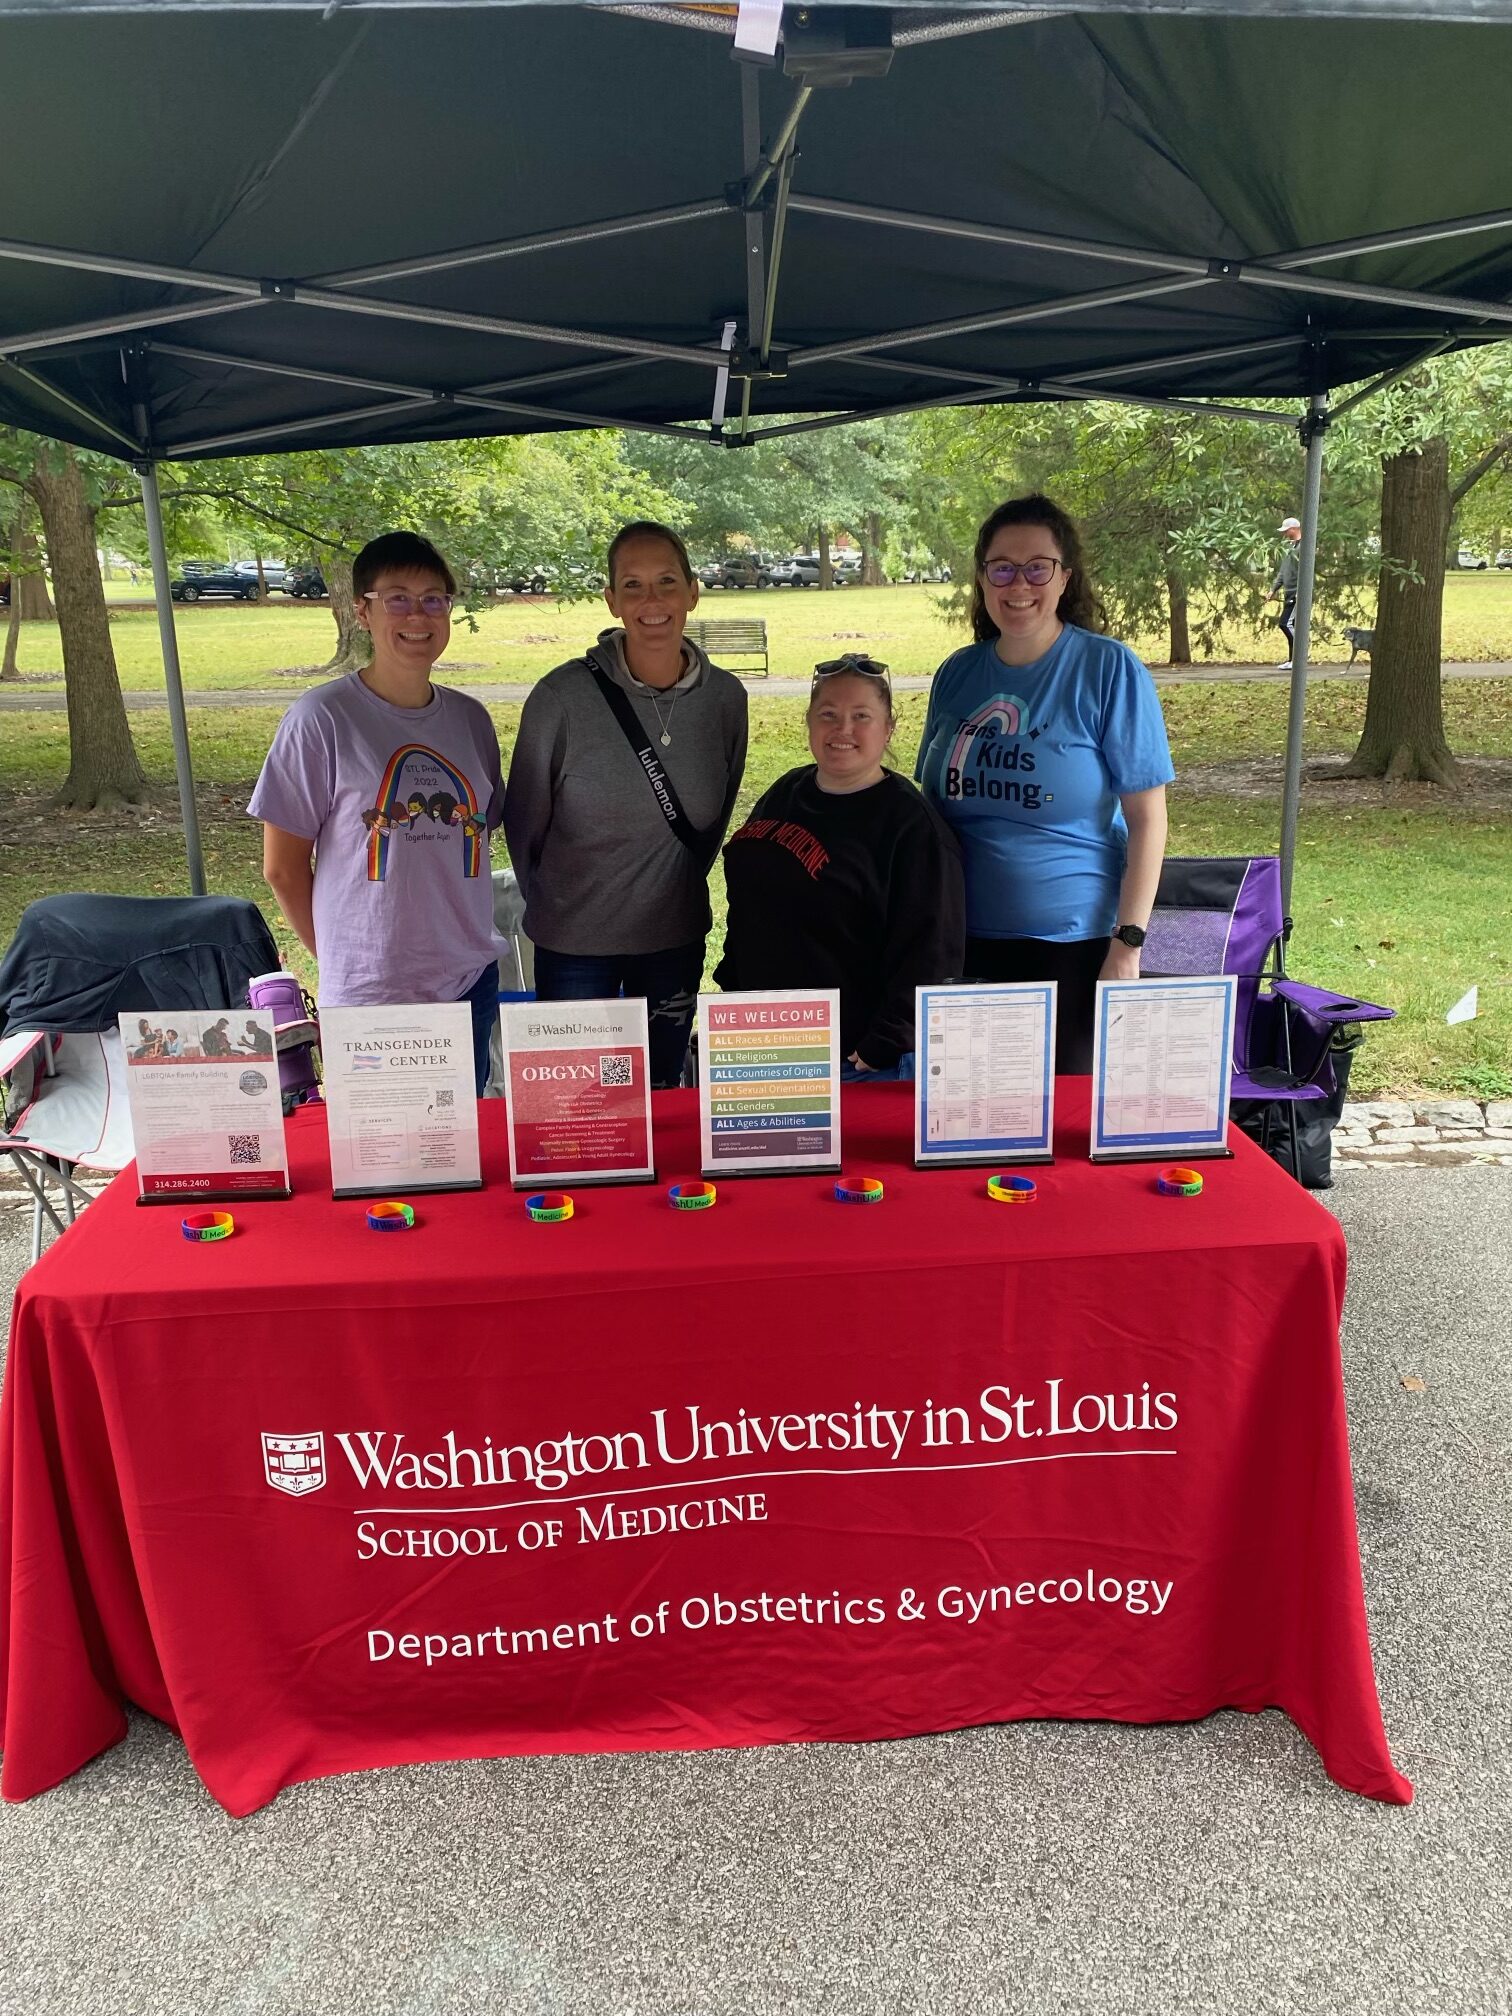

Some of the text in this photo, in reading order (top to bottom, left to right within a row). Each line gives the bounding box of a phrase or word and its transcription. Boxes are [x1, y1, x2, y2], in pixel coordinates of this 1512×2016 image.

[955, 719, 997, 739] Trans
[976, 741, 1036, 772] Kids
[414, 778, 439, 786] 2022
[638, 747, 677, 821] lululemon
[405, 832, 436, 843] Together
[770, 822, 831, 880] MEDICINE
[714, 1009, 825, 1024] WE WELCOME
[542, 1024, 623, 1035] WashU Medicine
[343, 1038, 452, 1052] TRANSGENDER
[715, 1033, 822, 1045] ALL Races & Ethnicities
[390, 1055, 448, 1066] CENTER
[715, 1052, 778, 1063] ALL Religions
[176, 1071, 198, 1079] Family
[200, 1071, 228, 1079] Building
[522, 1064, 596, 1081] OBGYN
[715, 1066, 822, 1079] ALL Countries of Origin
[716, 1083, 826, 1096] ALL Sexual Orientations
[716, 1101, 775, 1112] ALL Genders
[717, 1116, 806, 1129] ALL Ages & Abilities
[154, 1179, 210, 1188] 314.286.2400
[334, 1430, 651, 1491] Washington
[650, 1401, 916, 1465] University
[921, 1398, 974, 1447] in
[357, 1493, 769, 1560] SCHOOL OF MEDICINE
[367, 1569, 1175, 1666] Department of Obstetrics & Gynecology
